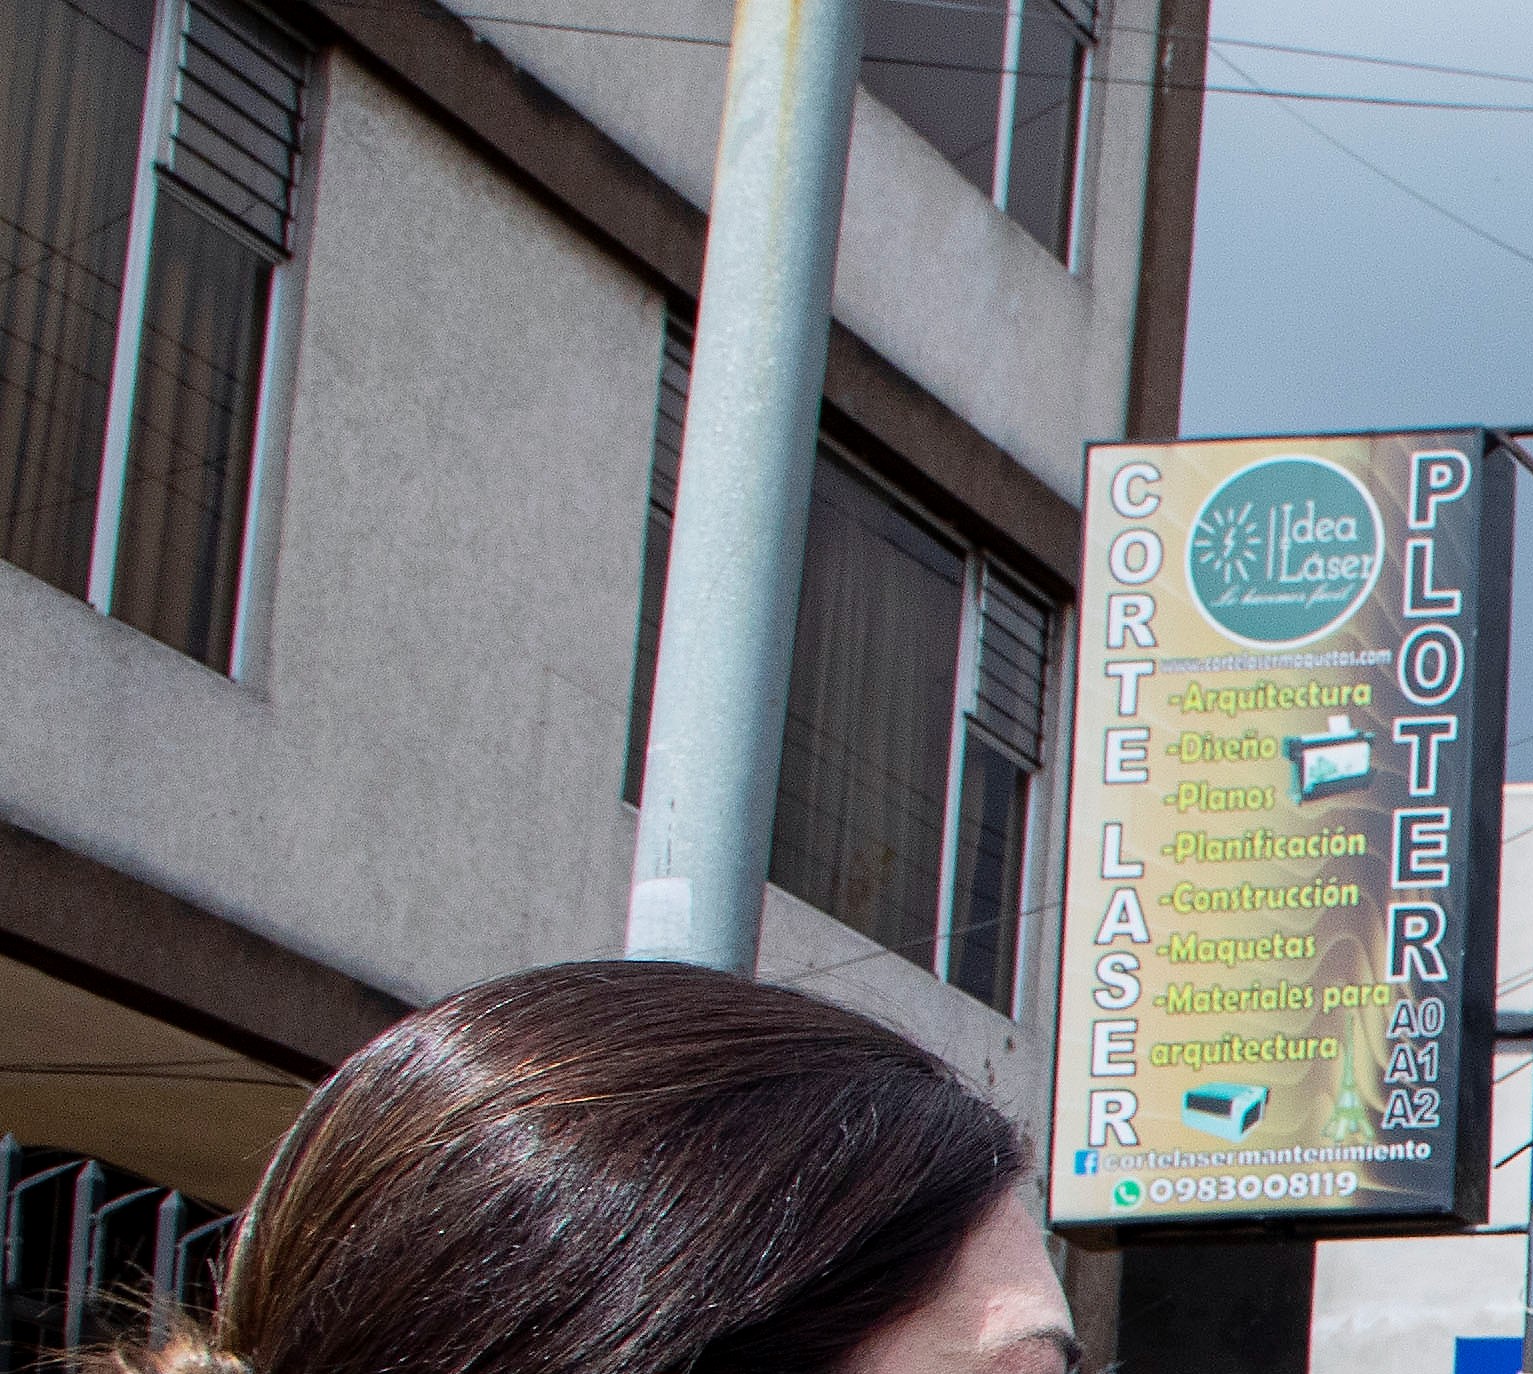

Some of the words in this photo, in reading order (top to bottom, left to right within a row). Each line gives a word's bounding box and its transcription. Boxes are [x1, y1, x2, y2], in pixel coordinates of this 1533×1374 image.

[1281, 500, 1358, 543] Idea
[1104, 461, 1164, 785] CORTE
[1386, 450, 1471, 984] PLOTER
[1088, 822, 1151, 1148] LASER
[1323, 984, 1391, 1014] para
[1386, 998, 1446, 1040] A0
[1150, 1033, 1339, 1070] arquitectura
[1384, 1041, 1441, 1084] A1
[1382, 1088, 1443, 1131] A2
[1149, 1171, 1358, 1205] 0983008119
